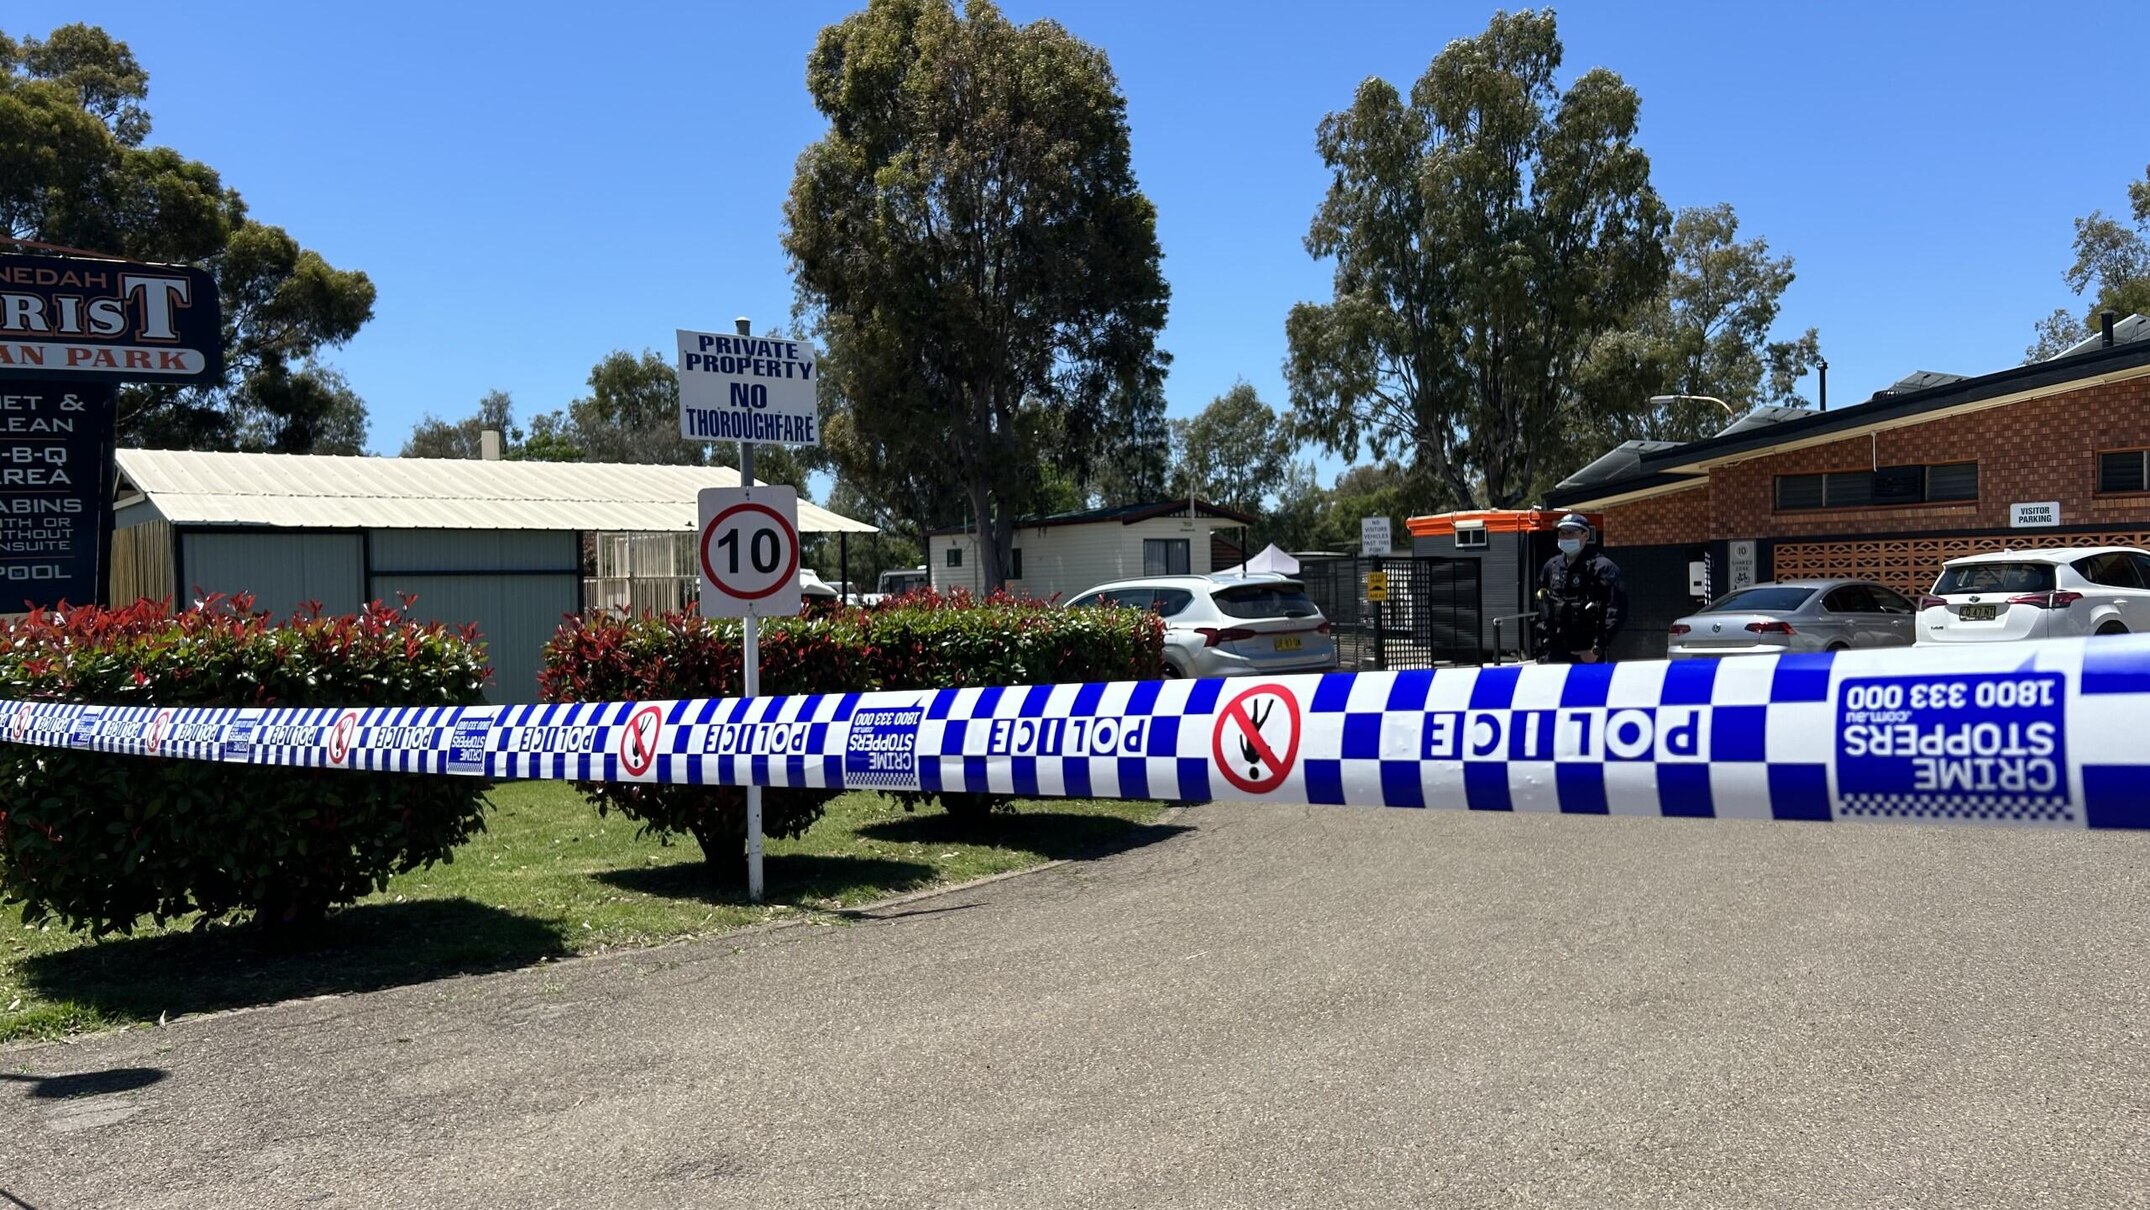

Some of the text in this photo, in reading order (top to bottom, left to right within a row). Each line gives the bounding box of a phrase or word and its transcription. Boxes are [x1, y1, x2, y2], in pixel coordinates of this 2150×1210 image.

[698, 334, 799, 360] PRIVATE
[66, 347, 188, 370] PARK
[686, 353, 813, 380] PROPERTY
[60, 394, 87, 412] &
[730, 382, 768, 409] NO
[686, 407, 815, 442] THOROUGHFARE
[0, 469, 72, 485] REA
[2018, 515, 2052, 524] PARKING
[2020, 506, 2050, 516] VISITOR
[43, 517, 71, 528] OR
[717, 528, 780, 574] 10
[1737, 546, 1747, 555] 10
[1846, 680, 2055, 711] 1800 333 000
[38, 716, 69, 733] POLICE
[855, 712, 920, 726] 1800 333 000
[1845, 710, 1912, 723] .com.au
[106, 720, 141, 738] POLICE
[179, 723, 217, 742] POLICE
[271, 725, 315, 747] POLICE
[376, 726, 433, 749] POLICE
[521, 726, 594, 752] POLICE
[706, 723, 807, 755] POLICE
[992, 718, 1147, 755] POLICE
[1430, 709, 1699, 758] POLICE
[1843, 721, 2057, 756] STOPPERS
[451, 735, 485, 748] STOPPERS
[849, 733, 914, 752] STOPPERS
[460, 748, 482, 761] CRIME
[868, 752, 912, 770] CRIME
[1912, 757, 2057, 791] CRIME
